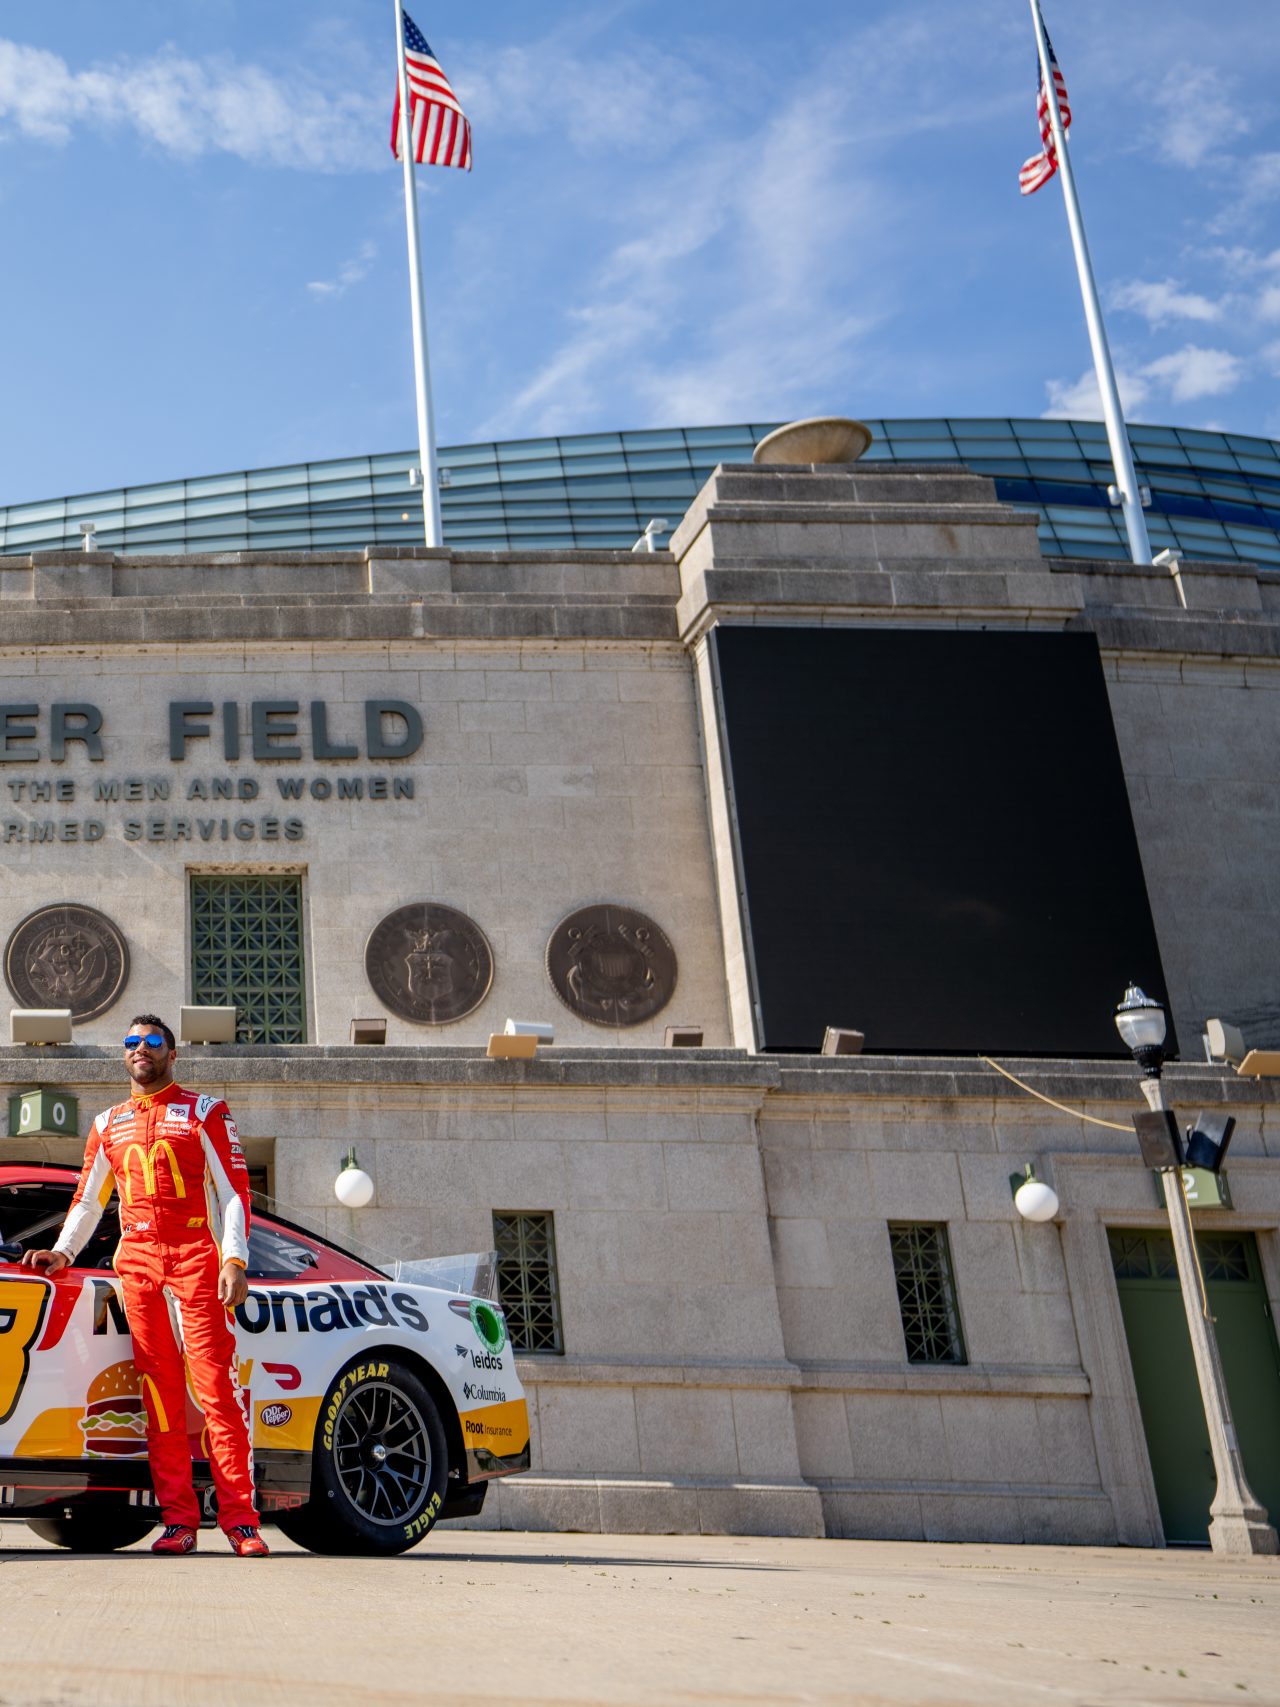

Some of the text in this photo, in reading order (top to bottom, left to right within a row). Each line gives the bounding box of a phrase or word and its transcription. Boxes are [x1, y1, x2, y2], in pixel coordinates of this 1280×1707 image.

[169, 699, 425, 762] FIELD
[9, 779, 75, 804] THE
[94, 778, 170, 802] MEN
[187, 776, 259, 801] AND
[277, 776, 415, 801] WOMEN
[123, 815, 306, 841] SERVICES
[53, 1102, 66, 1126] 0
[1182, 1173, 1198, 1199] 2
[471, 1350, 503, 1370] leidos
[470, 1384, 506, 1402] Columbia
[265, 1407, 289, 1424] Pepper
[271, 1405, 282, 1415] Dr
[323, 1363, 390, 1451] GOODYEAR
[466, 1421, 512, 1436] Root Insurance
[404, 1491, 442, 1540] EAGLE
